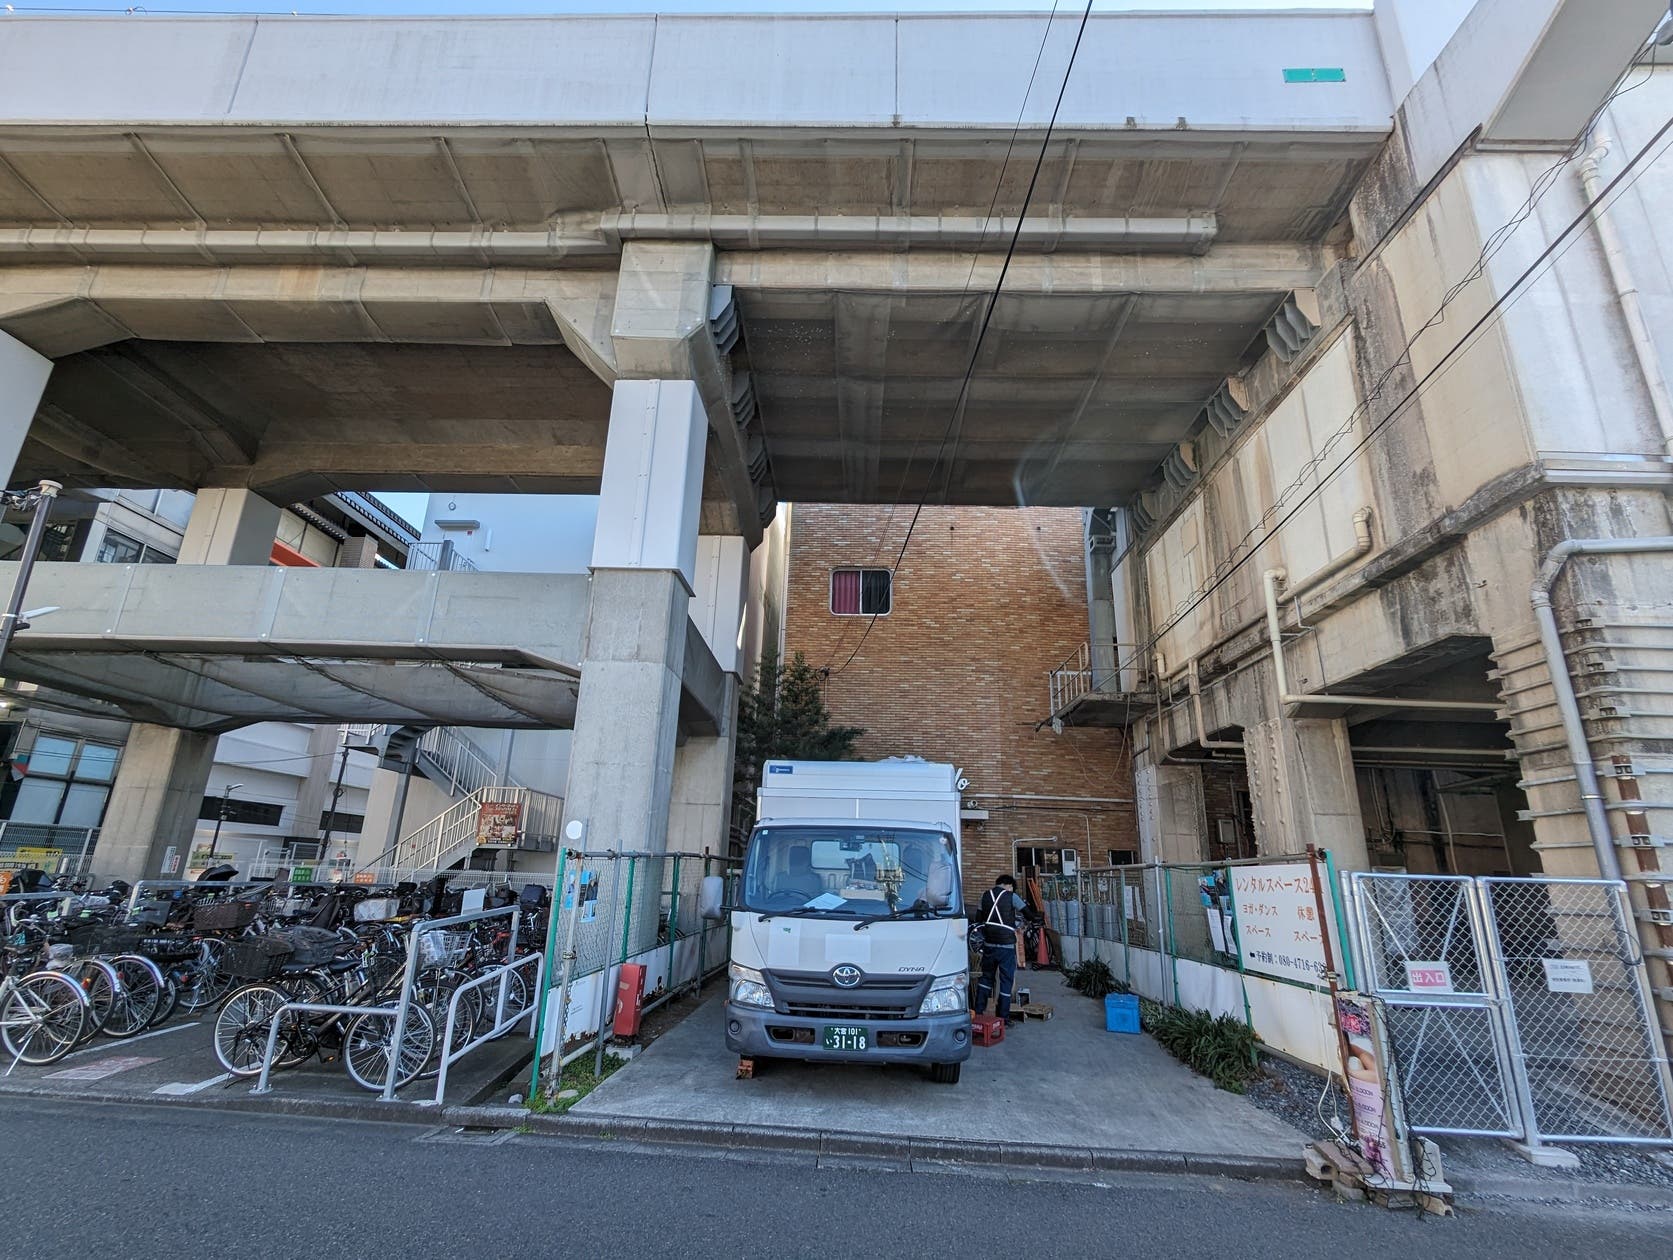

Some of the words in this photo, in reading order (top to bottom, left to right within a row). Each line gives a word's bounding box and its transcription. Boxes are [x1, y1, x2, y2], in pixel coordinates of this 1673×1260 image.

[1246, 925, 1271, 938] スペース
[1294, 931, 1323, 945] スペー
[1412, 972, 1445, 983] 出入口
[848, 1027, 858, 1035] 101
[833, 1035, 866, 1050] 31-18
